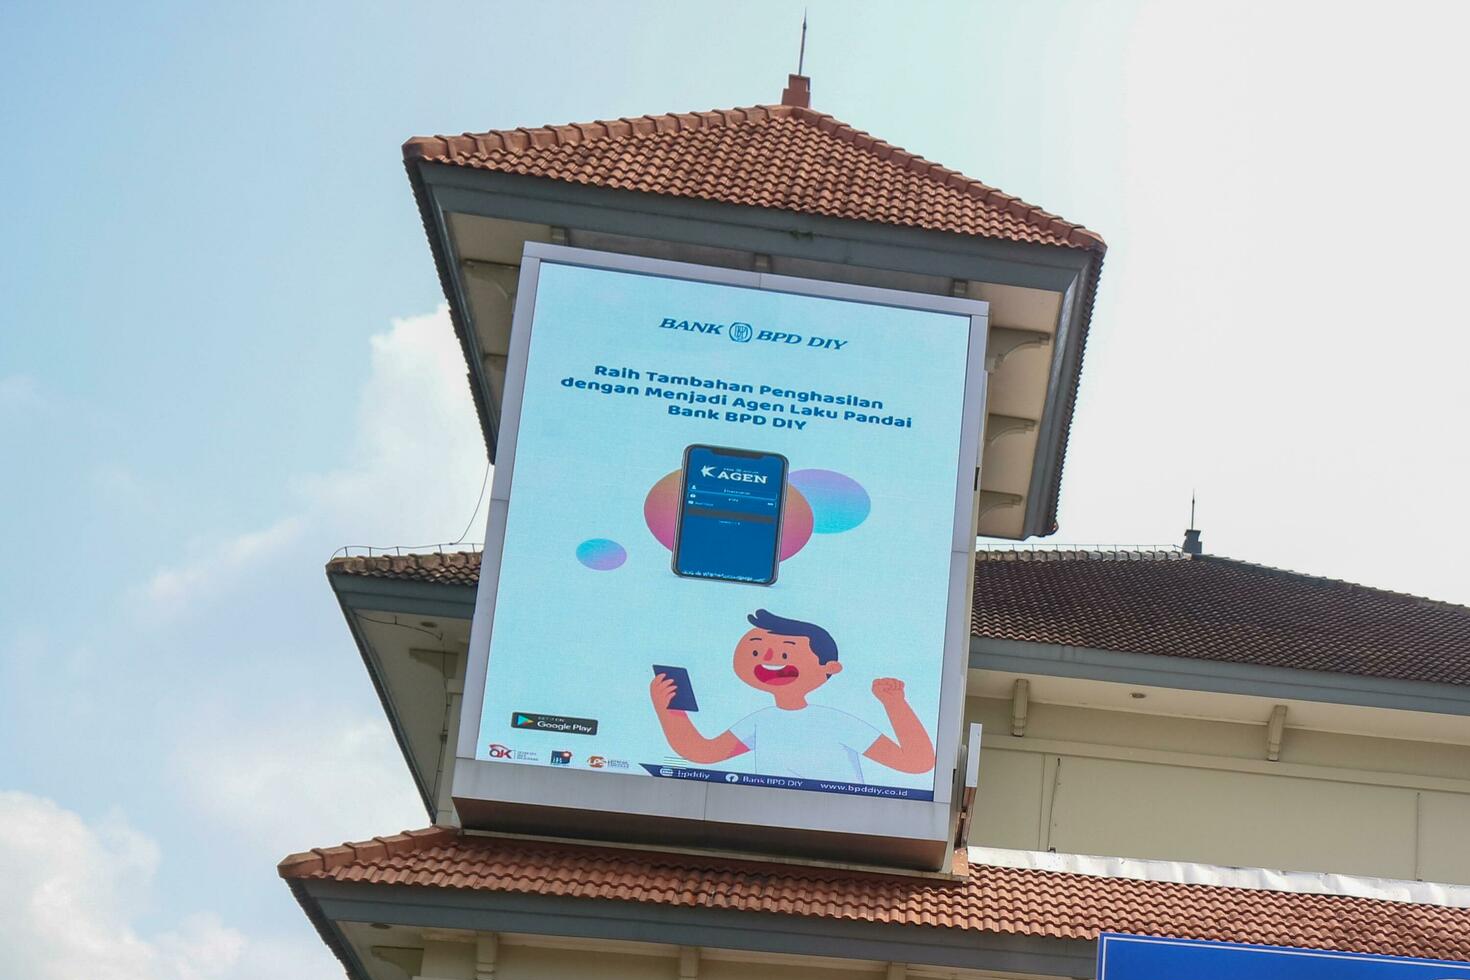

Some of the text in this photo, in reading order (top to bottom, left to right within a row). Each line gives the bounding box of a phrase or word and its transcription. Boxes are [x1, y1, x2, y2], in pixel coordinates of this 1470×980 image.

[659, 318, 848, 351] BANK BPD DIY
[594, 365, 883, 410] Raih Tambahan Penghasilan
[560, 377, 912, 428] dengan Menjadi Agen Laku Pandai
[668, 405, 807, 431] Bank BPD DIY
[717, 471, 768, 485] AGEN
[537, 720, 593, 733] Google Play
[742, 775, 765, 784] Bank
[820, 783, 908, 797] www.bpddiy.co.id
